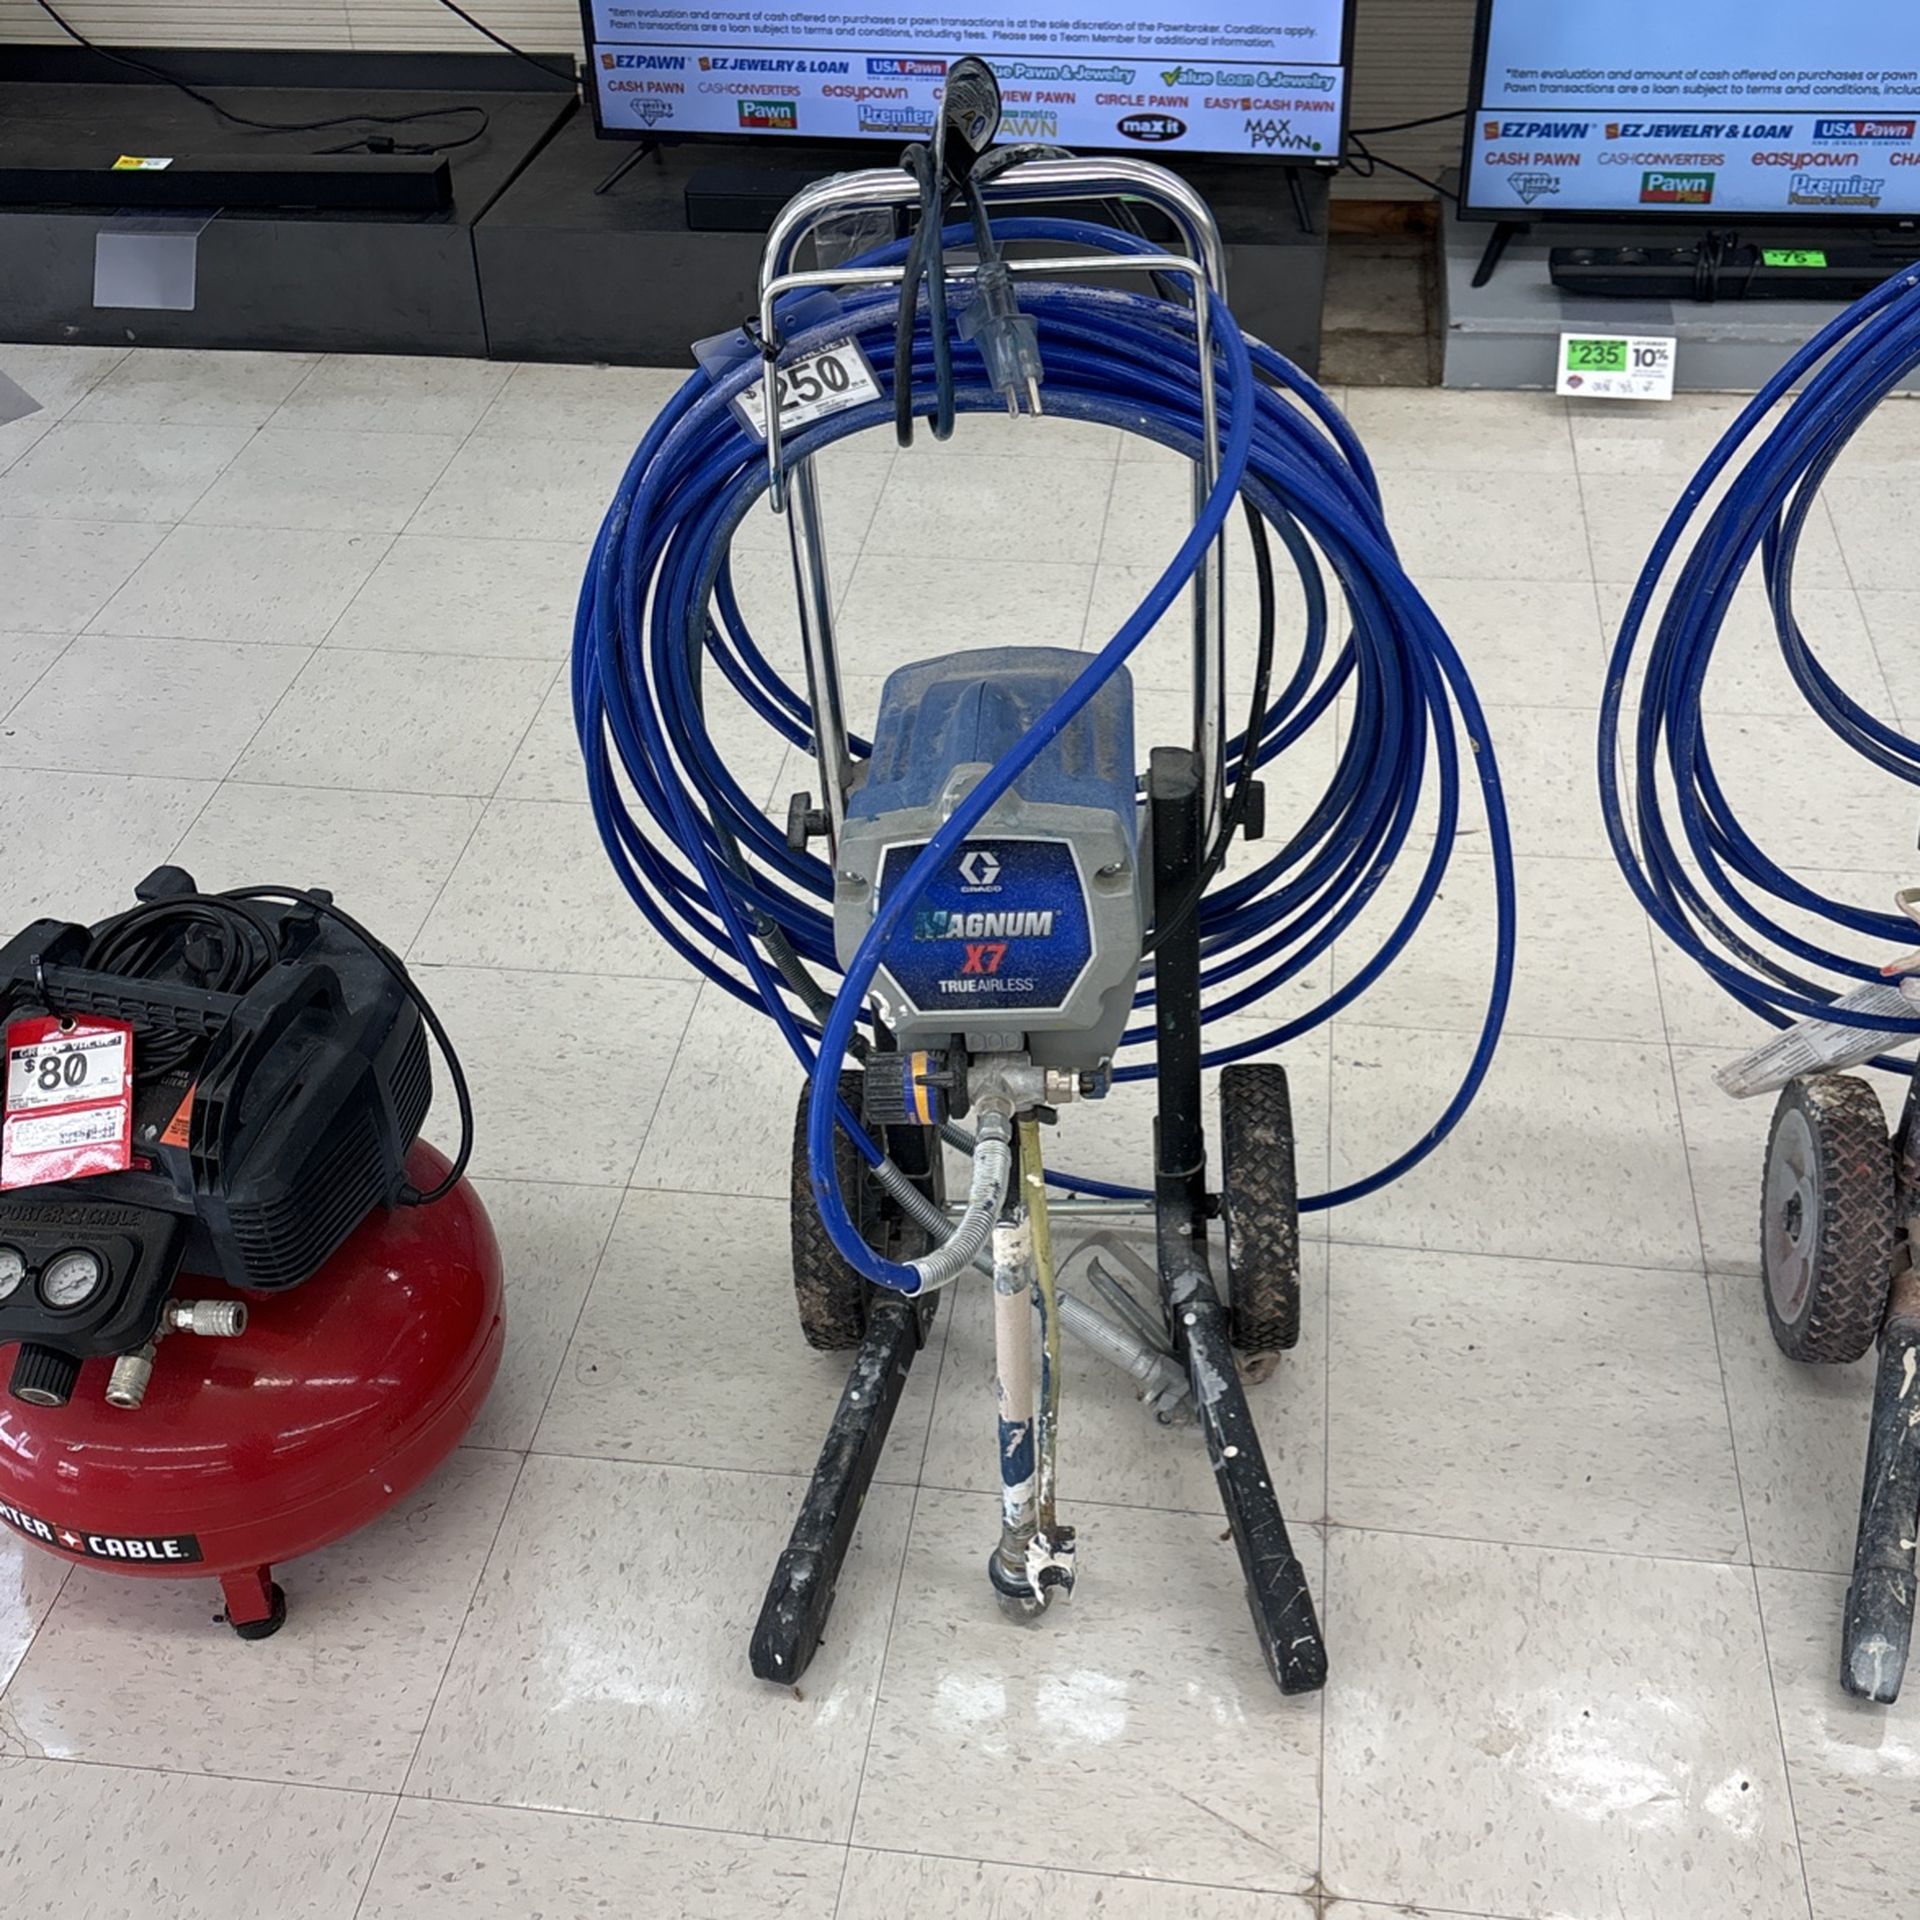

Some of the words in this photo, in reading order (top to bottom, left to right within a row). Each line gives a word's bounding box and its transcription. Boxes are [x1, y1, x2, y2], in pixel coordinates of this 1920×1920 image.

[637, 8, 688, 19] evaluation
[690, 9, 710, 19] and
[711, 11, 750, 20] amount
[752, 11, 763, 21] of
[764, 11, 788, 22] cash
[790, 12, 826, 23] offered
[828, 15, 841, 23] on
[843, 14, 896, 26] purchases
[898, 17, 908, 25] or
[910, 18, 939, 28] pawn
[941, 17, 1004, 28] transactions
[1017, 19, 1027, 28] at
[1029, 19, 1047, 29] the
[1049, 19, 1069, 30] sole
[1072, 19, 1122, 31] discretion
[1125, 22, 1136, 31] of
[1137, 22, 1155, 32] the
[1223, 24, 1281, 35] Conditions
[610, 19, 637, 30] Pawn
[639, 20, 699, 32] transactions
[701, 23, 717, 32] are
[729, 23, 752, 33] loan
[753, 24, 789, 36] subject
[792, 25, 802, 35] to
[804, 25, 832, 36] terms
[835, 26, 855, 37] and
[914, 28, 961, 41] including
[992, 30, 1026, 41] Please
[1029, 33, 1047, 42] see
[1060, 32, 1089, 43] Team
[1092, 33, 1135, 44] Member
[1138, 35, 1152, 45] for
[1154, 35, 1208, 46] additional
[615, 54, 686, 70] EZPAWN
[711, 57, 728, 70] EZ
[728, 58, 795, 73] JEWELRY
[795, 60, 807, 74] &
[810, 60, 849, 74] LOAN
[871, 59, 900, 73] USA
[905, 62, 942, 74] Pawn
[1014, 63, 1060, 80] Pawn
[1060, 65, 1074, 81] &
[1074, 66, 1136, 85] Jewelry
[1216, 71, 1254, 88] Loan
[1256, 72, 1270, 88] &
[1271, 72, 1336, 92] Jewelry
[1540, 68, 1605, 80] evaluation
[1606, 69, 1632, 80] and
[1634, 70, 1682, 81] amount
[1684, 69, 1698, 81] of
[1699, 69, 1730, 81] cash
[1732, 69, 1778, 81] offered
[1779, 71, 1796, 81] on
[1796, 70, 1864, 83] purchases
[1866, 71, 1879, 81] or
[1880, 71, 1918, 84] pawn
[608, 80, 644, 93] CASH
[647, 82, 685, 95] PAWN
[698, 82, 802, 97] CASHCONVERTERS
[822, 84, 909, 102] easypawn
[1504, 82, 1537, 93] Pawn
[1539, 83, 1615, 94] transactions
[1617, 85, 1639, 94] are
[1641, 85, 1650, 95] a
[1652, 83, 1680, 94] loan
[1682, 83, 1728, 97] subject
[1730, 84, 1744, 95] to
[1746, 84, 1783, 95] terms
[1785, 84, 1811, 95] and
[1036, 91, 1075, 105] PAWN
[1095, 93, 1145, 107] CIRCLE
[1149, 95, 1189, 109] PAWN
[1203, 97, 1241, 110] EASY
[1253, 98, 1291, 111] CASH
[1294, 99, 1335, 112] PAWN
[743, 102, 791, 118] Pawn
[858, 104, 934, 124] Premier
[1020, 109, 1058, 120] metro
[1000, 119, 1058, 138] AWN
[1243, 119, 1291, 134] MAX
[1501, 121, 1590, 139] EZPAWN
[1620, 123, 1644, 138] EZ
[1643, 123, 1725, 139] JEWELRY
[1724, 124, 1740, 140] &
[1741, 124, 1793, 140] LOAN
[1821, 122, 1857, 137] USA
[1861, 123, 1908, 137] Pawn
[1485, 151, 1530, 166] CASH
[1533, 151, 1581, 167] PAWN
[1597, 151, 1726, 167] CASHCONVERTERS
[1751, 151, 1859, 171] easypawn
[1647, 173, 1707, 192] Pawn
[1790, 173, 1885, 195] Premier
[914, 911, 1054, 941] MAGNUM
[961, 943, 1008, 974] X7
[88, 1536, 183, 1559] CABLE
